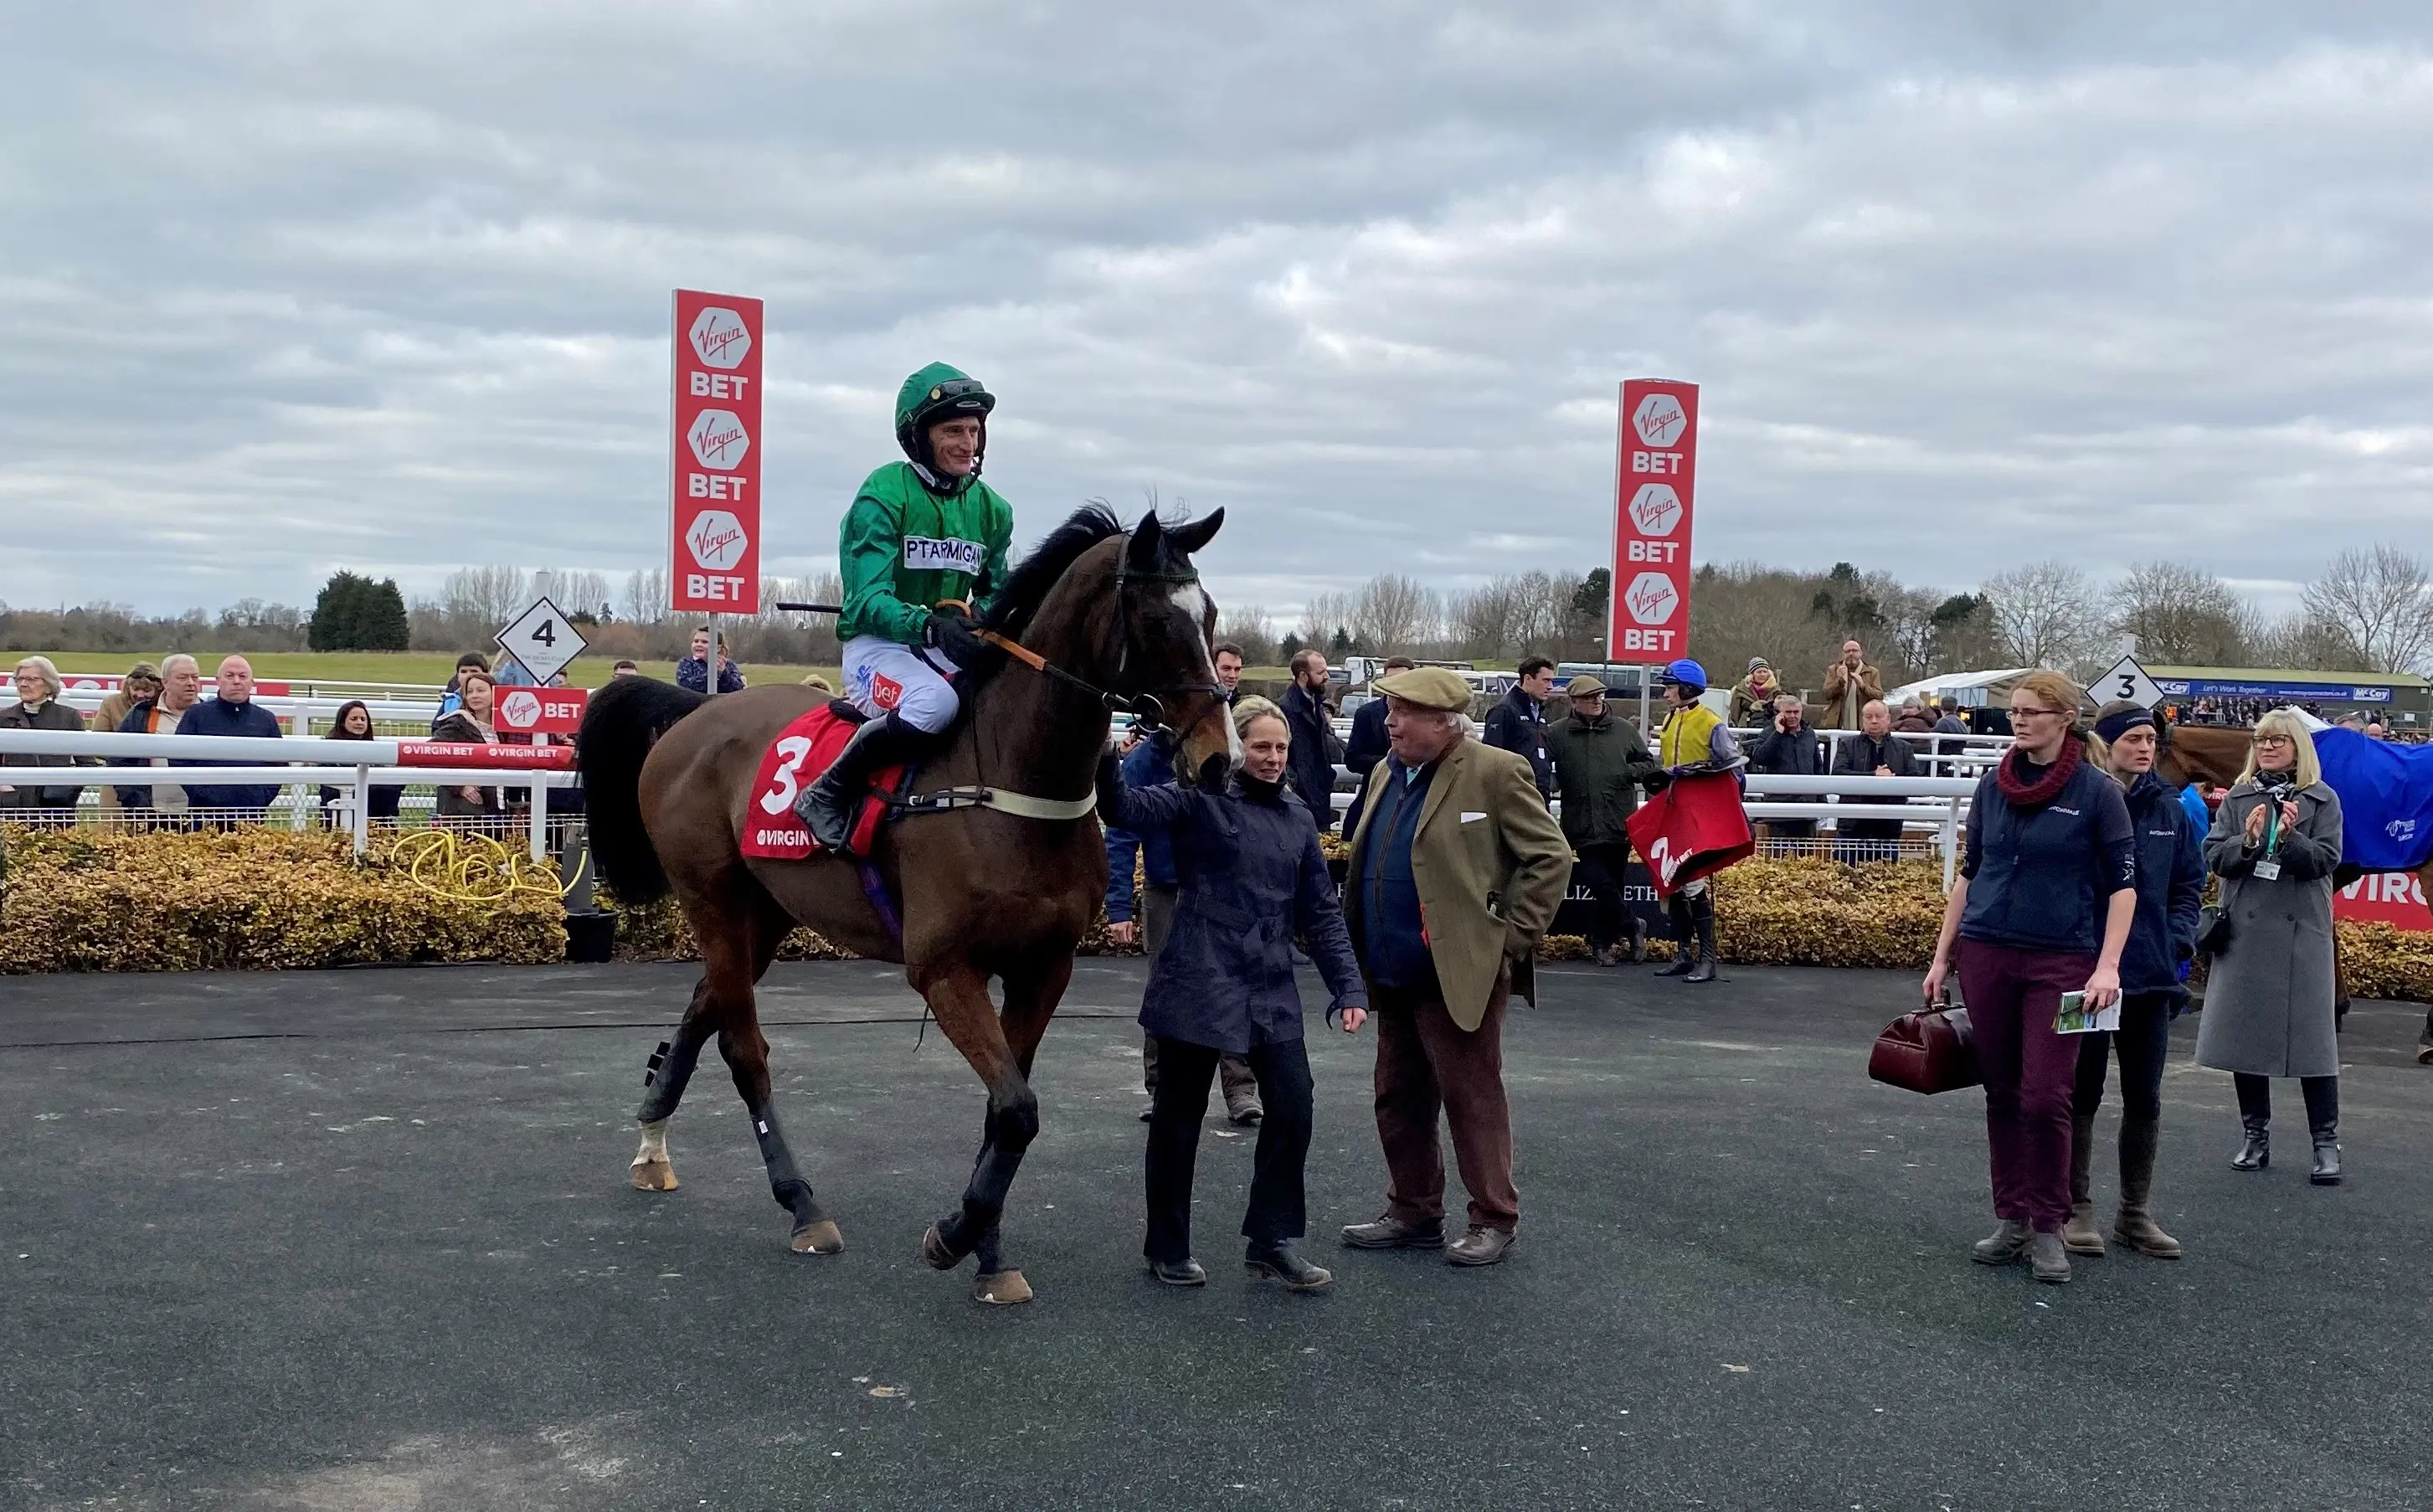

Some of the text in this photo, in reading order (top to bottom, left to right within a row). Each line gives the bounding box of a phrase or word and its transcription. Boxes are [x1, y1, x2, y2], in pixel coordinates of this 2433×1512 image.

[698, 316, 744, 360] Virgin
[690, 371, 748, 400] BET
[1641, 401, 1681, 440] Virgin
[696, 417, 742, 461] Virgin
[1632, 450, 1684, 475] BET
[688, 472, 747, 501] BET
[1636, 490, 1677, 529] Virgin
[694, 518, 740, 562] Virgin
[907, 540, 981, 568] PTARMIGAN
[1628, 540, 1679, 563] BET
[687, 573, 745, 601] BET
[1632, 579, 1673, 618] Virgin
[532, 620, 555, 647] 4
[1624, 628, 1675, 651] BET
[875, 676, 898, 707] bet
[2116, 674, 2136, 699] 3
[507, 697, 581, 723] Virgin BET
[412, 745, 475, 756] VIRGIN BET
[498, 748, 558, 758] VIRGIN BET
[760, 736, 812, 815] 3
[766, 829, 810, 846] VIRGIN
[1651, 836, 1674, 882] 2
